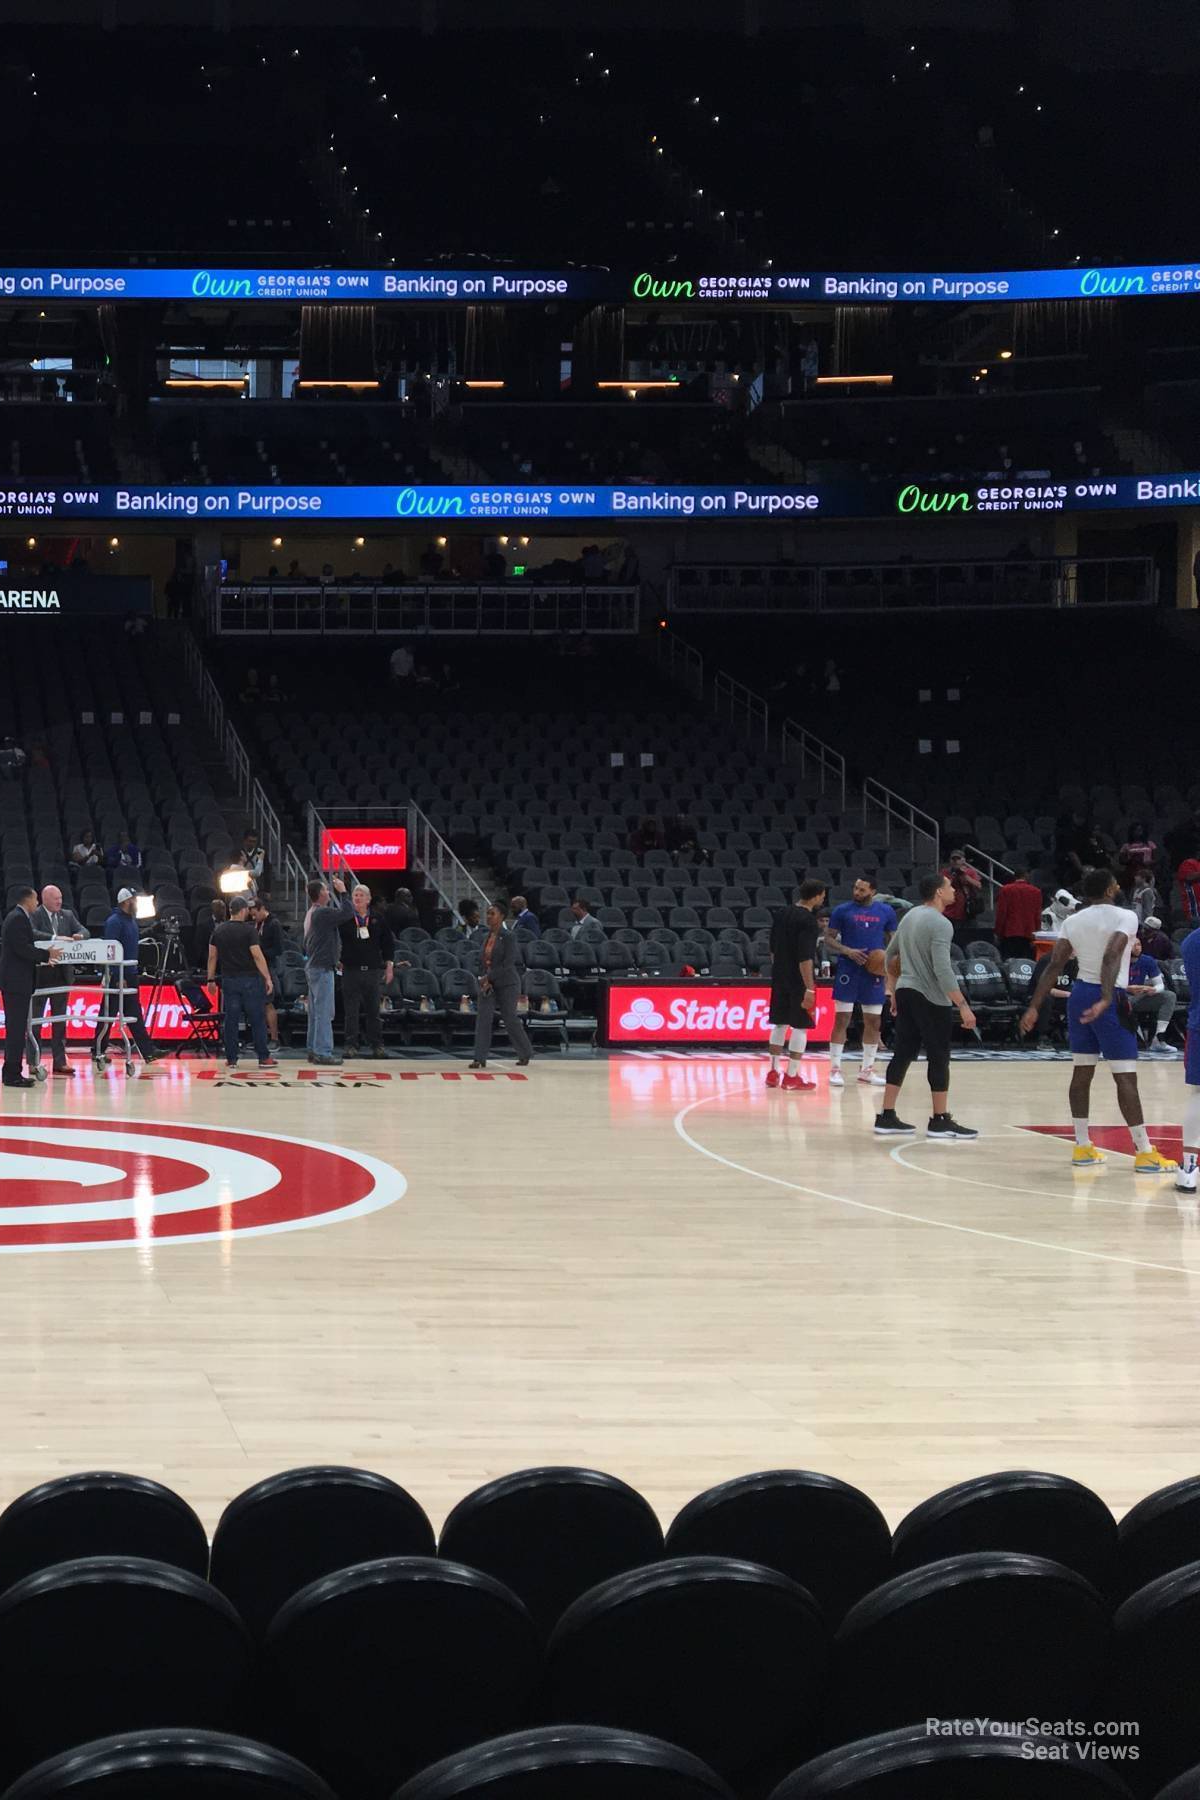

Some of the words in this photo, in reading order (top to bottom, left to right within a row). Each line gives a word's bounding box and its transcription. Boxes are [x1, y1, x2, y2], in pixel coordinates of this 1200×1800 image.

[20, 278, 43, 290] on
[51, 274, 125, 294] Purpose
[193, 271, 253, 296] Own
[258, 276, 331, 286] GEORGIA'S
[337, 276, 369, 286] OWN
[384, 276, 457, 296] Banking
[462, 281, 485, 292] on
[493, 277, 567, 296] Purpose
[634, 273, 695, 298] Own
[699, 277, 772, 288] GEORGIA'S
[778, 278, 810, 288] OWN
[825, 277, 897, 298] Banking
[902, 282, 925, 293] on
[932, 277, 1009, 297] Purpose
[1081, 269, 1147, 294] Own
[1152, 283, 1189, 292] CREDIT
[258, 288, 293, 296] CREDIT
[296, 288, 328, 296] UNION
[699, 290, 735, 298] CREDIT
[737, 290, 768, 298] UNION
[63, 492, 99, 504] OWN
[470, 492, 552, 504] GEORGIA'S
[559, 493, 595, 504] OWN
[897, 484, 973, 512] Own
[977, 486, 1067, 500] GEORGIA'S
[1075, 483, 1117, 496] OWN
[17, 505, 52, 514] UNION
[116, 492, 198, 514] Banking
[204, 497, 230, 510] on
[238, 493, 321, 515] Purpose
[397, 487, 466, 515] Own
[612, 492, 694, 514] Banking
[701, 497, 726, 510] on
[734, 492, 819, 513] Purpose
[977, 501, 1019, 510] CREDIT
[1025, 500, 1063, 509] UNION
[470, 505, 510, 515] CREDIT
[513, 505, 549, 515] UNION
